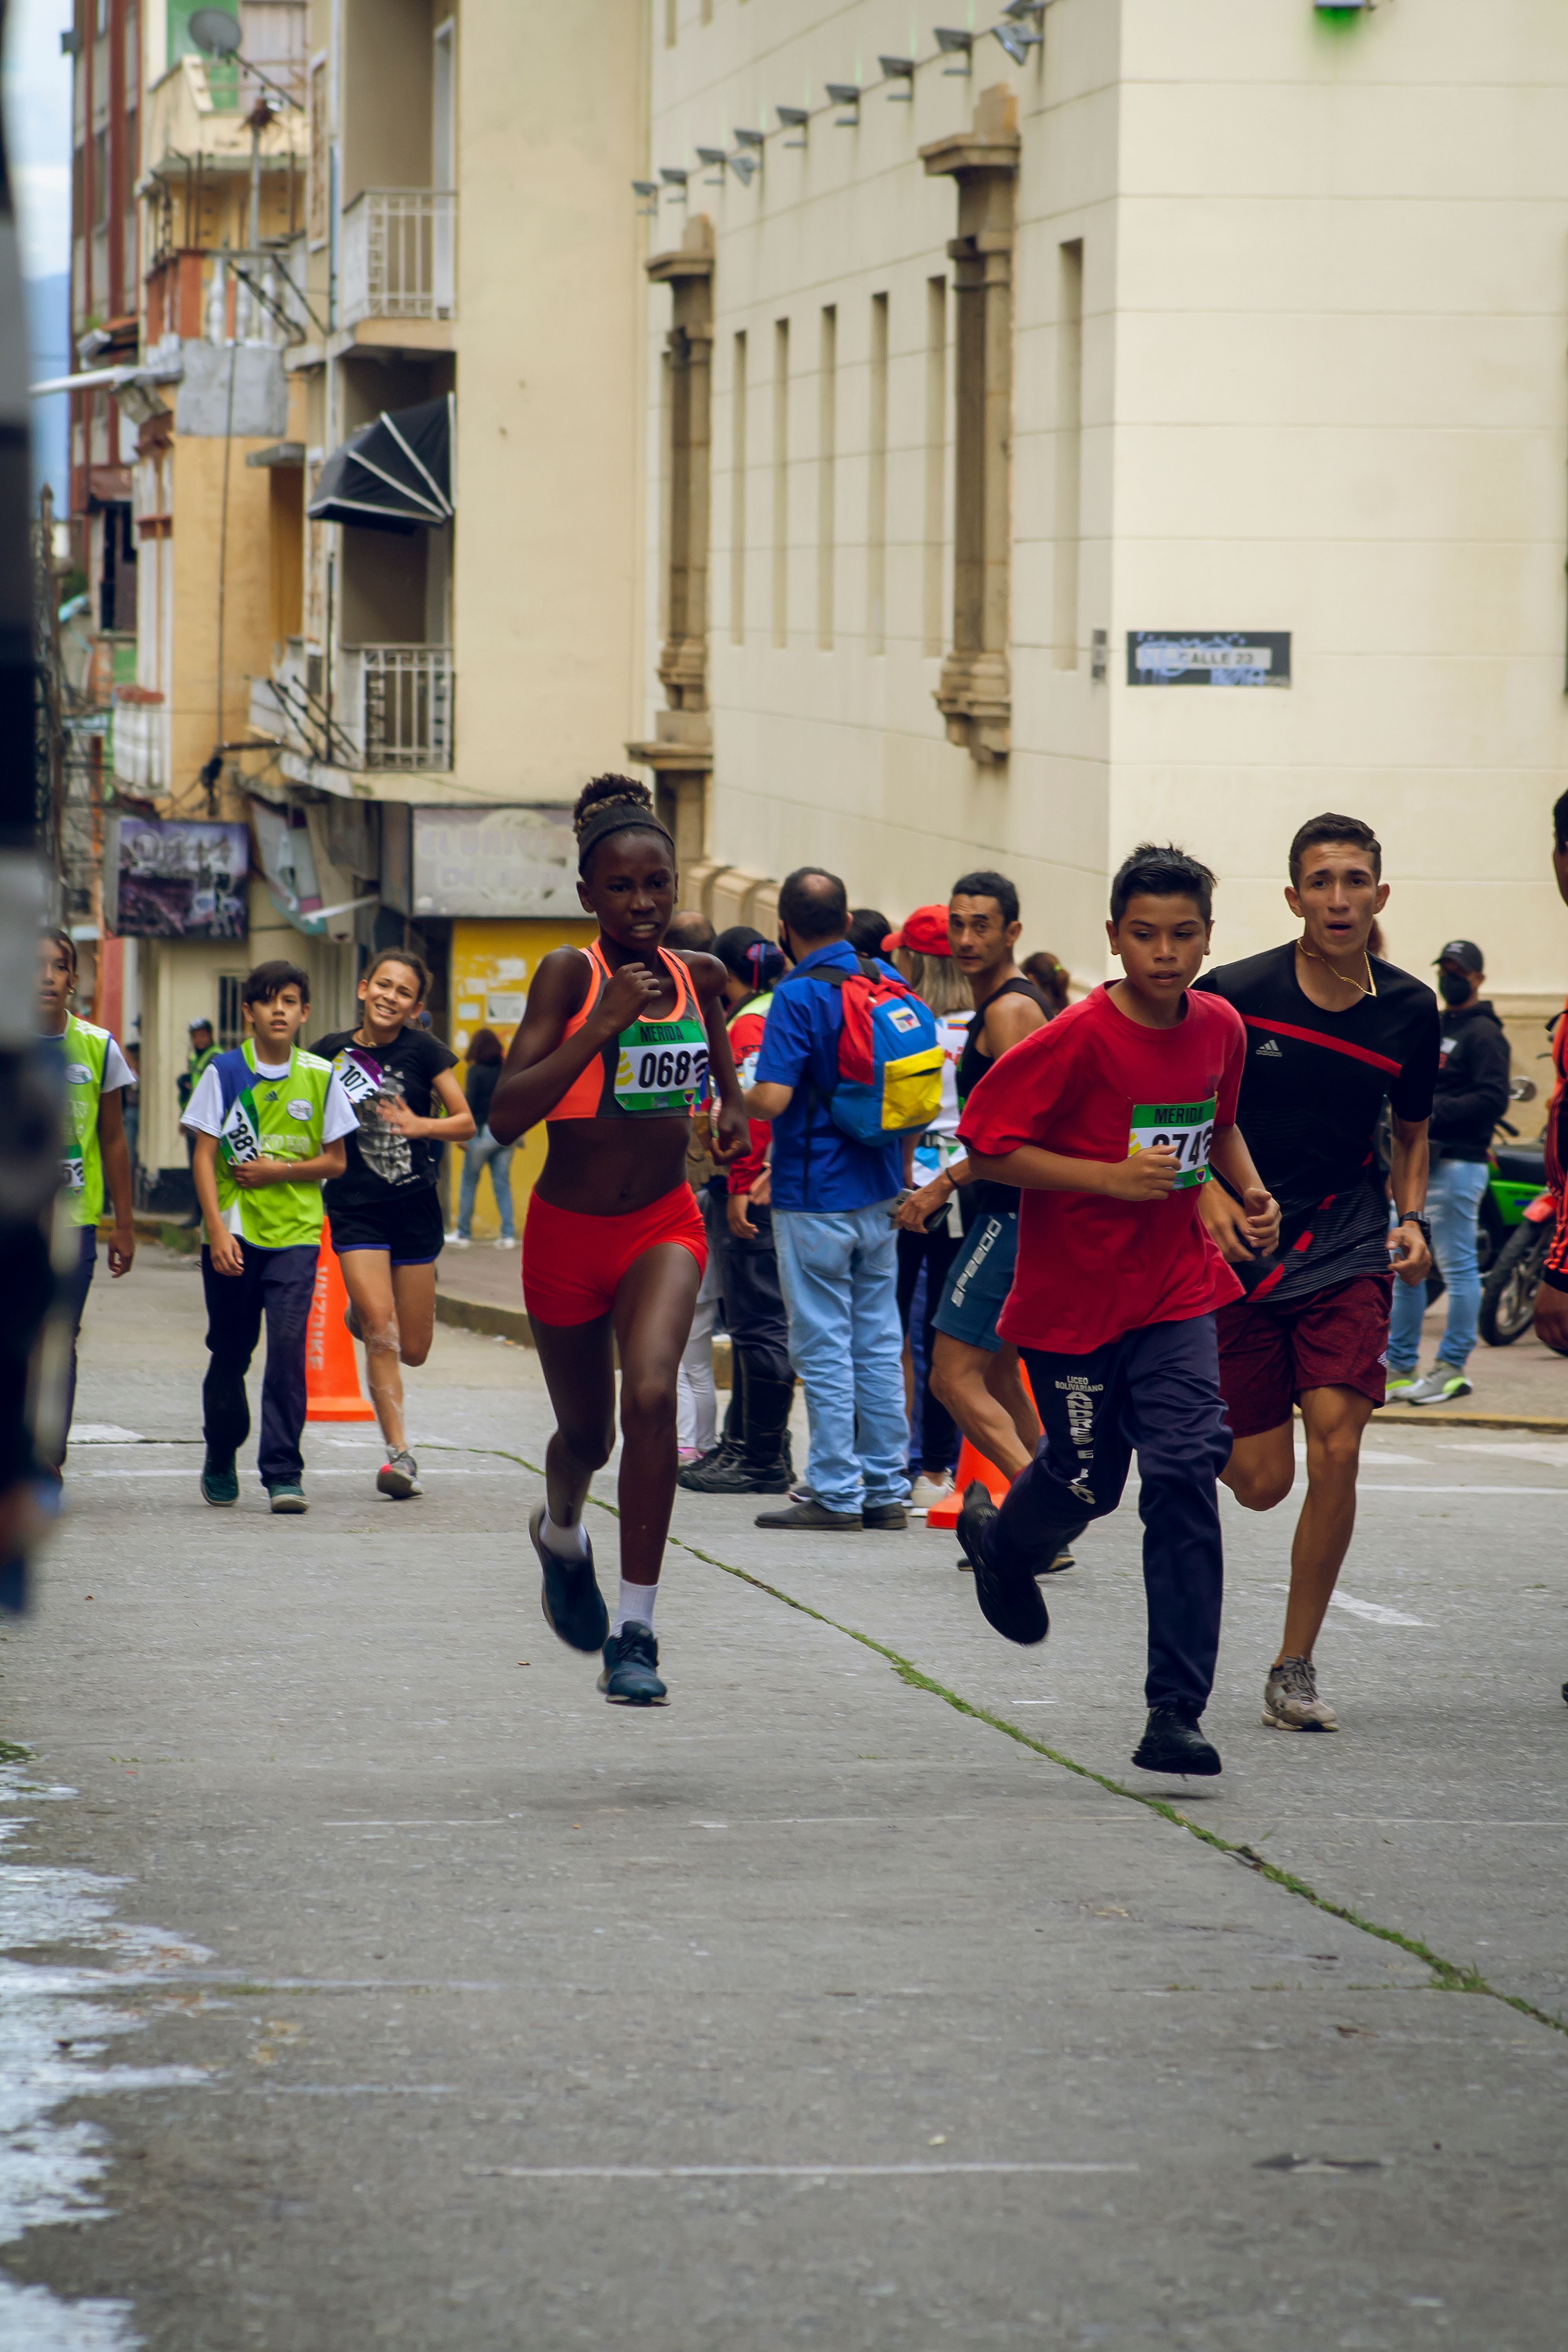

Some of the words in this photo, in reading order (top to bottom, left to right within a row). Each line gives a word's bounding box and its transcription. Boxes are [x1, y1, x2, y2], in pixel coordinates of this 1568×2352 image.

[339, 1064, 368, 1092] 107
[638, 1051, 691, 1089] 068
[1054, 1380, 1104, 1393] BOLIVARIANO
[1066, 1375, 1089, 1385] LICEO
[1065, 1391, 1094, 1445] ANDRES
